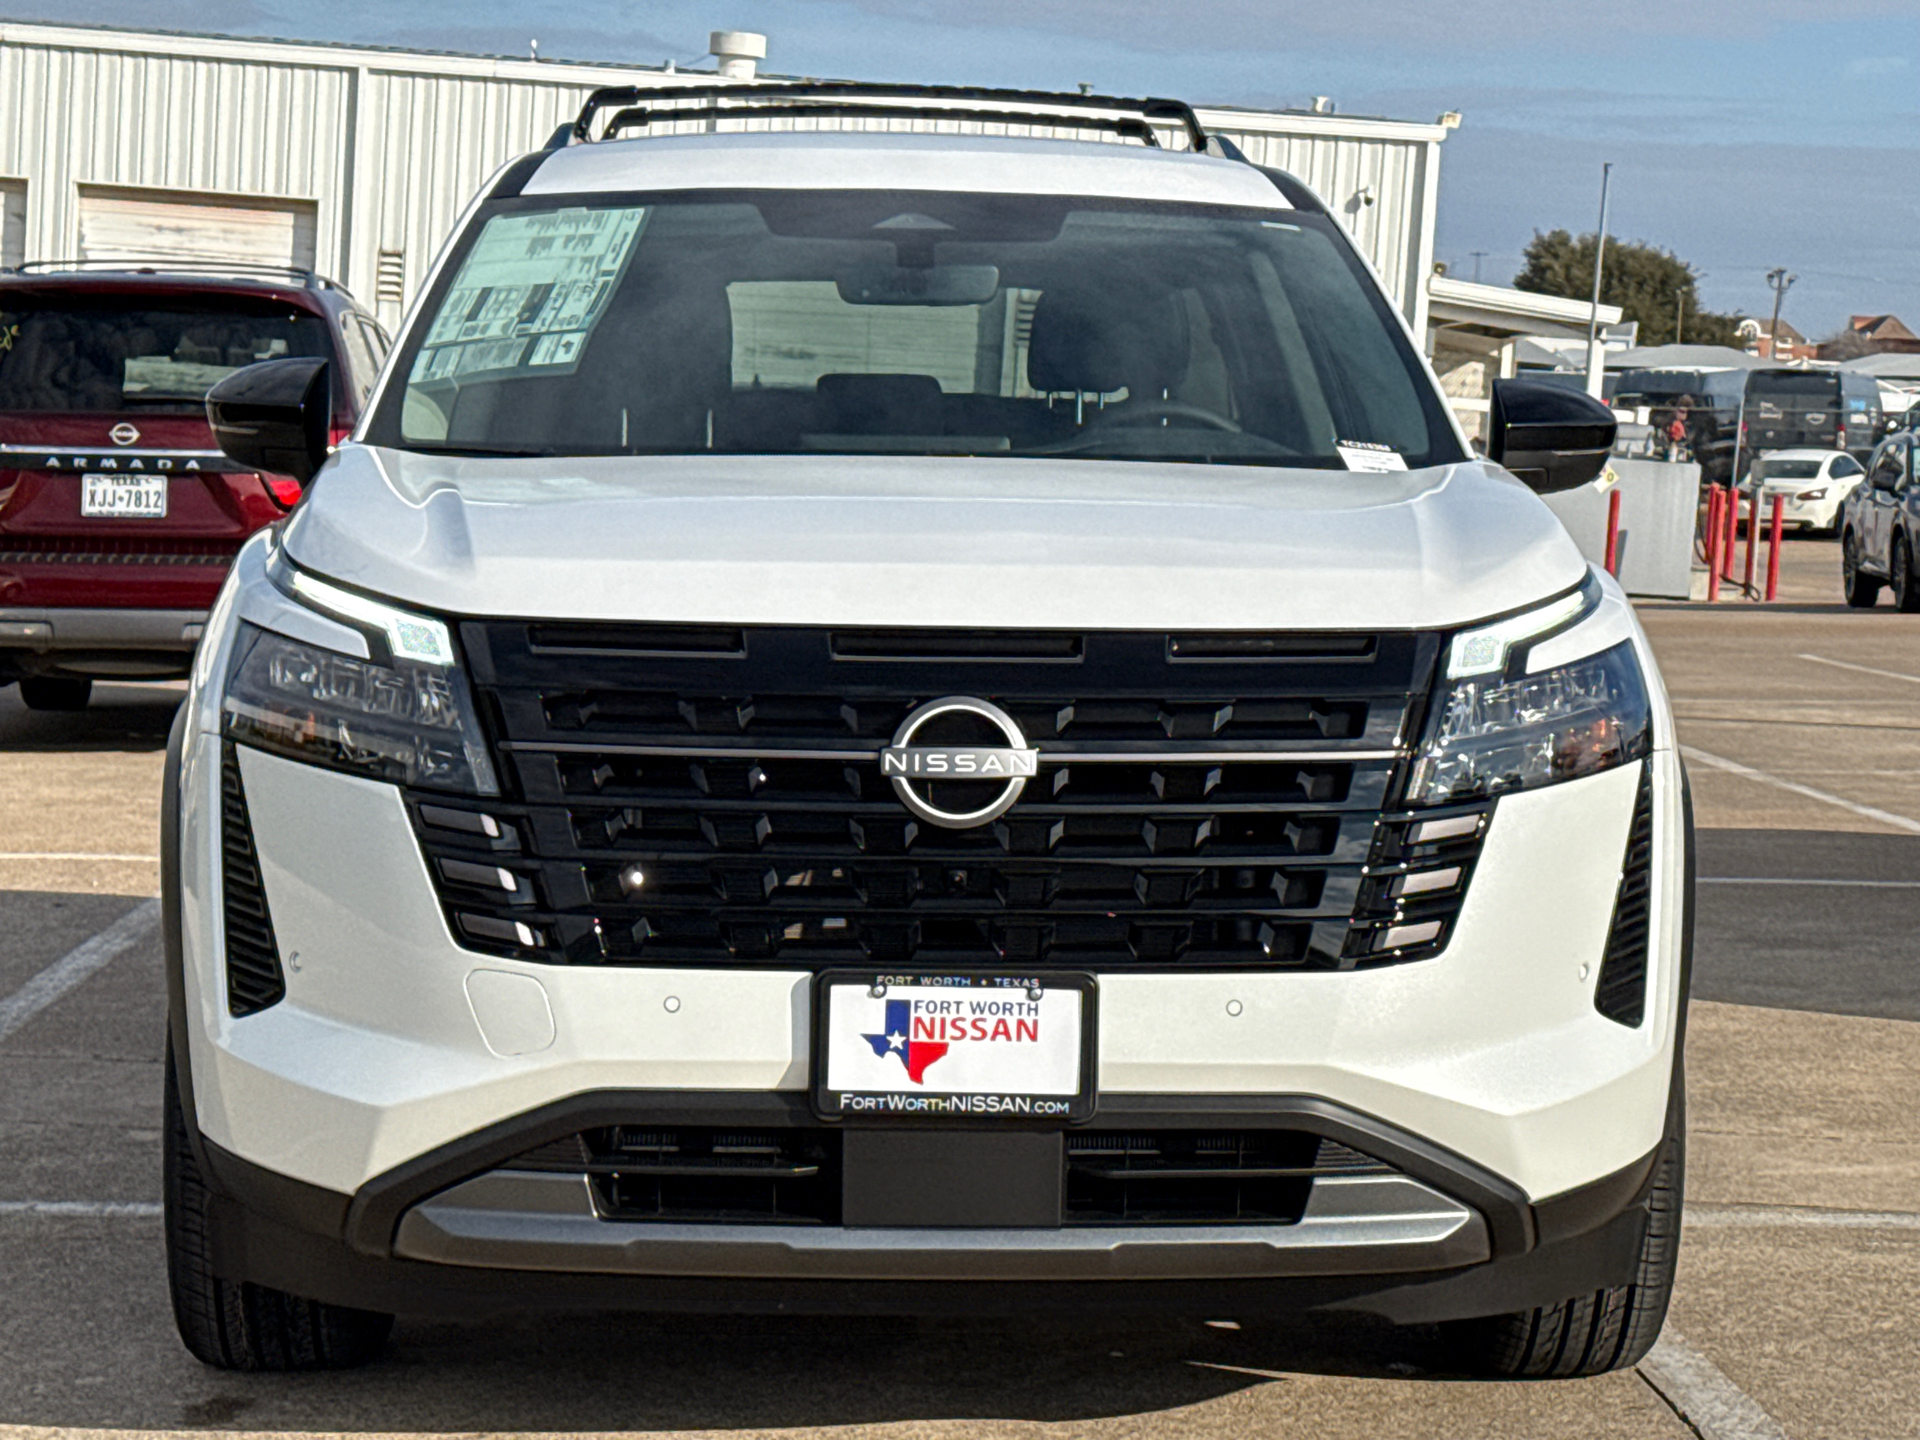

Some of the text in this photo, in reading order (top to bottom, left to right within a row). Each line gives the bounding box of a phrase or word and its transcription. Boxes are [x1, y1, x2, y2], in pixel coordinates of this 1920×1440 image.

[46, 456, 200, 470] ARMADA
[884, 753, 1034, 773] NISSAN
[876, 975, 1040, 989] FORT WORTH TEXAS
[913, 1000, 1039, 1017] FORT WORTH
[913, 1016, 1039, 1042] NISSAN
